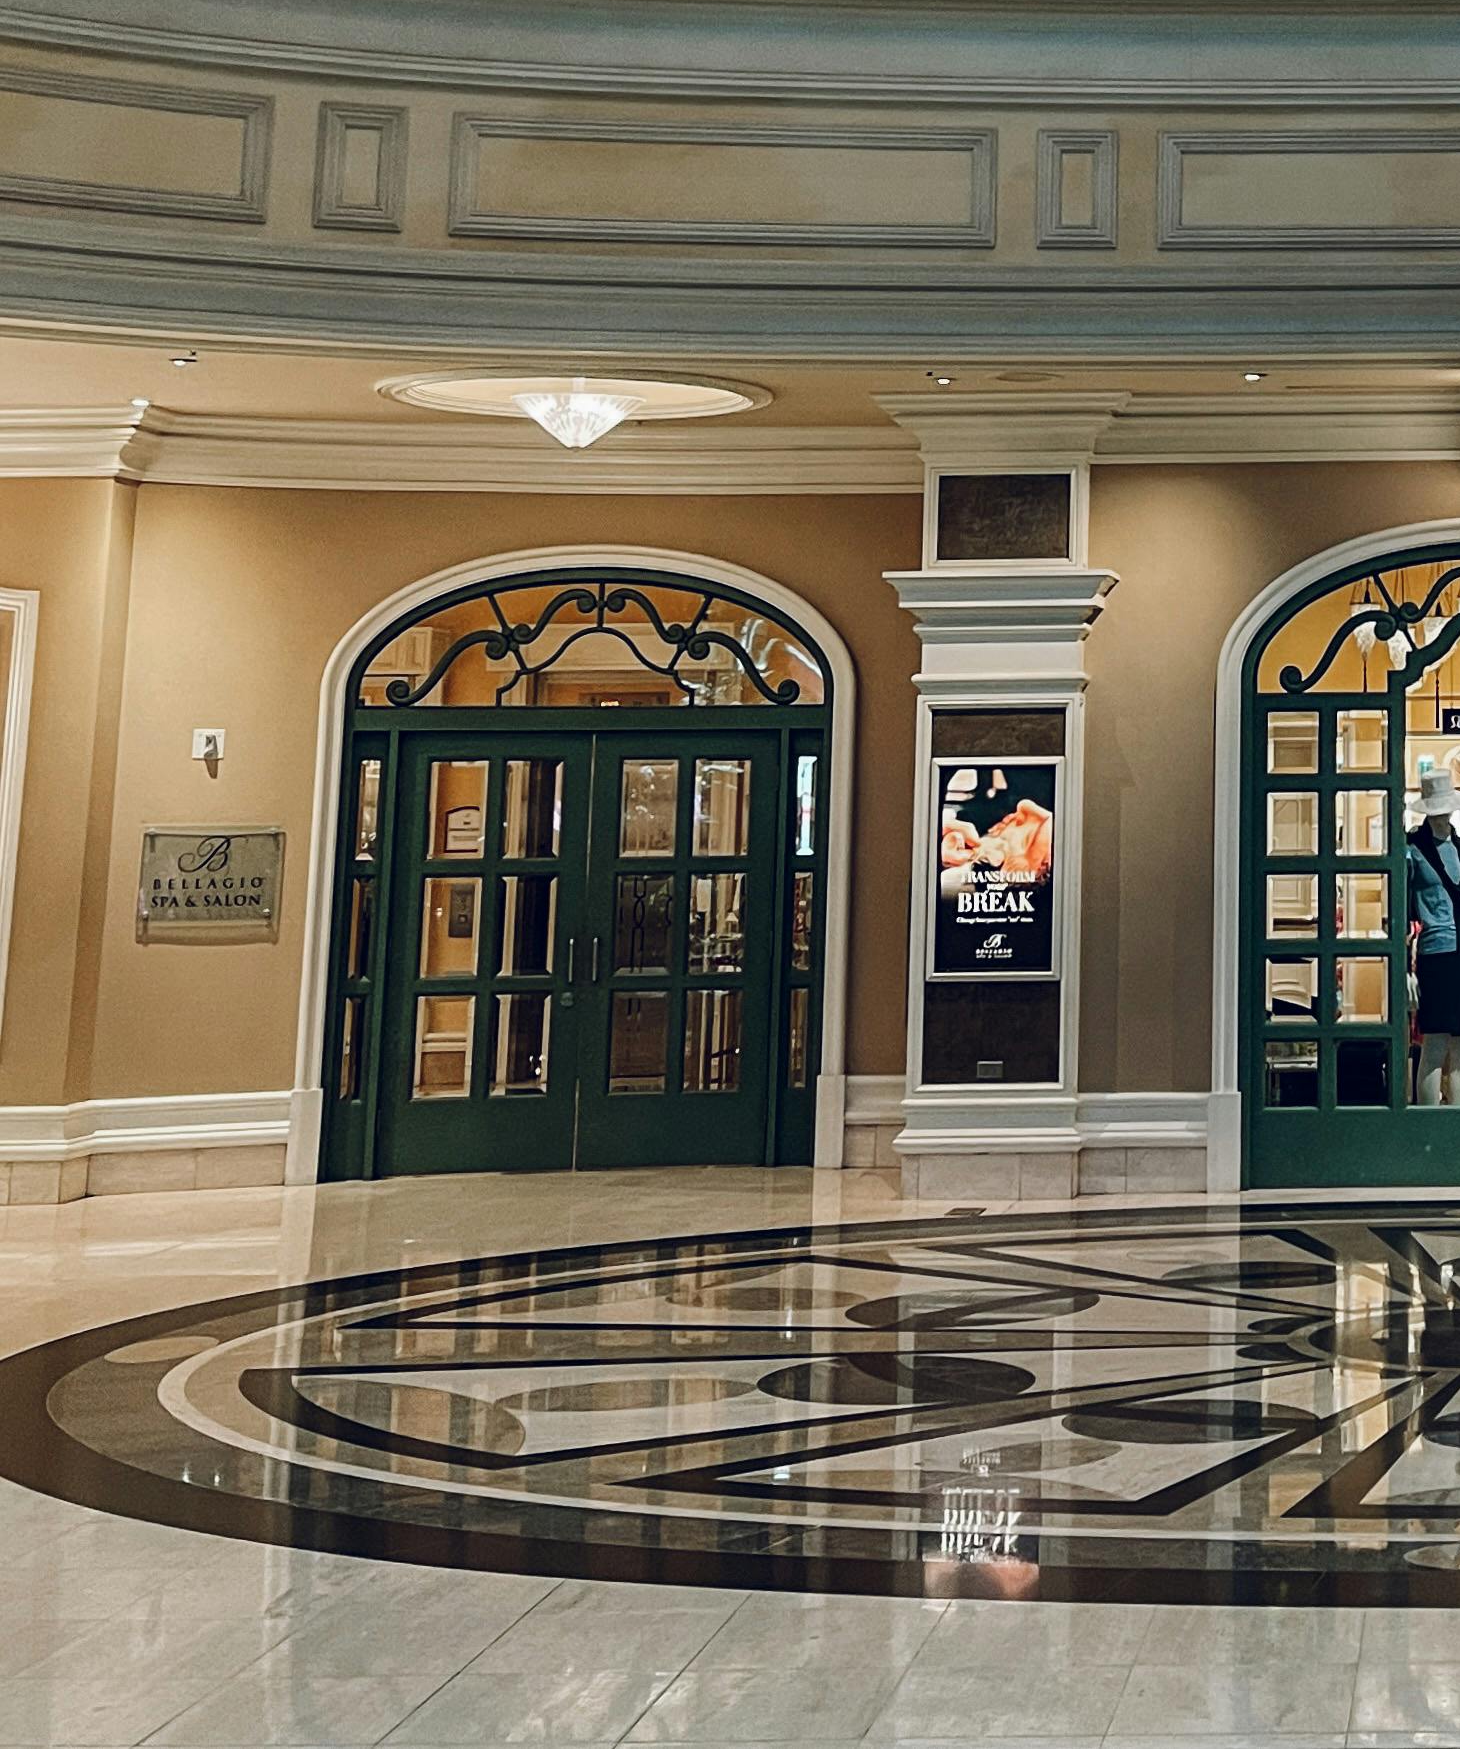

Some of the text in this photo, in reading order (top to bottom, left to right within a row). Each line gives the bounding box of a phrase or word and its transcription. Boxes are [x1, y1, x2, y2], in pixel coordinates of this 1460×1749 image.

[961, 870, 1036, 883] TRANSFORM
[153, 877, 266, 890] BELLAGIO
[151, 894, 262, 908] SPA & SALON
[957, 891, 1035, 913] BREAK
